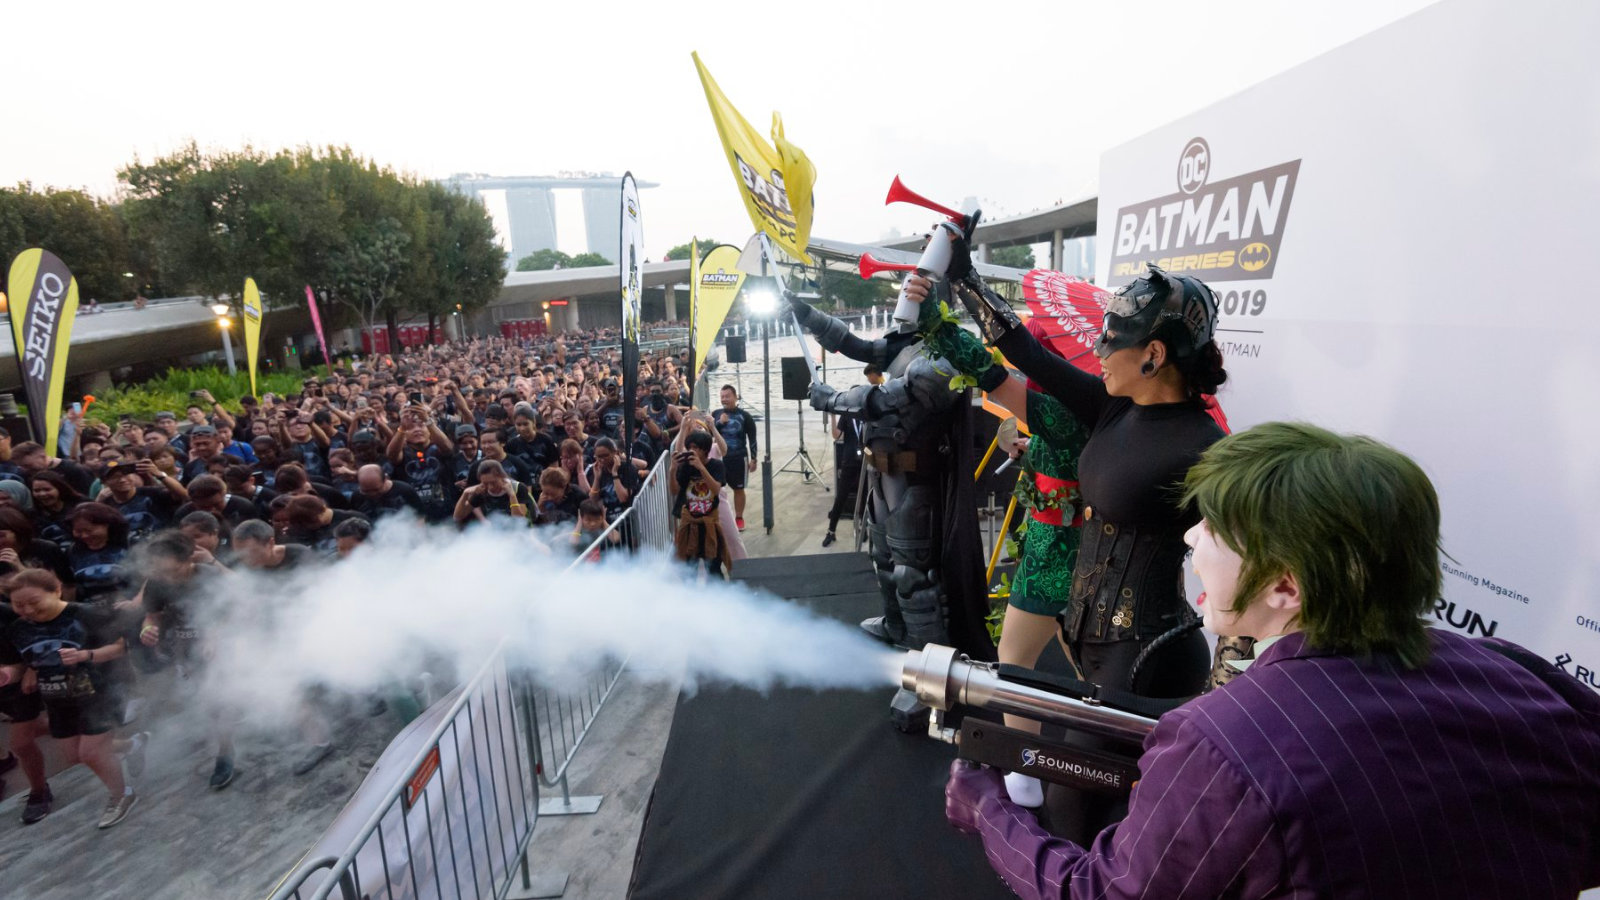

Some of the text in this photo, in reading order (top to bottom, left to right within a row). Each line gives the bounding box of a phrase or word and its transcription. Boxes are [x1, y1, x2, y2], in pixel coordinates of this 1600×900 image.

[1181, 151, 1205, 185] DC
[1116, 174, 1289, 257] BATMAN
[1117, 250, 1236, 275] RUN SERIES
[703, 274, 739, 282] BATMAN
[26, 273, 64, 381] SEIKO
[1219, 341, 1261, 359] ATMAN
[1442, 562, 1530, 605] Running Magazine
[1576, 615, 1600, 633] Offi
[1037, 755, 1120, 785] SOUNDIMAGE
